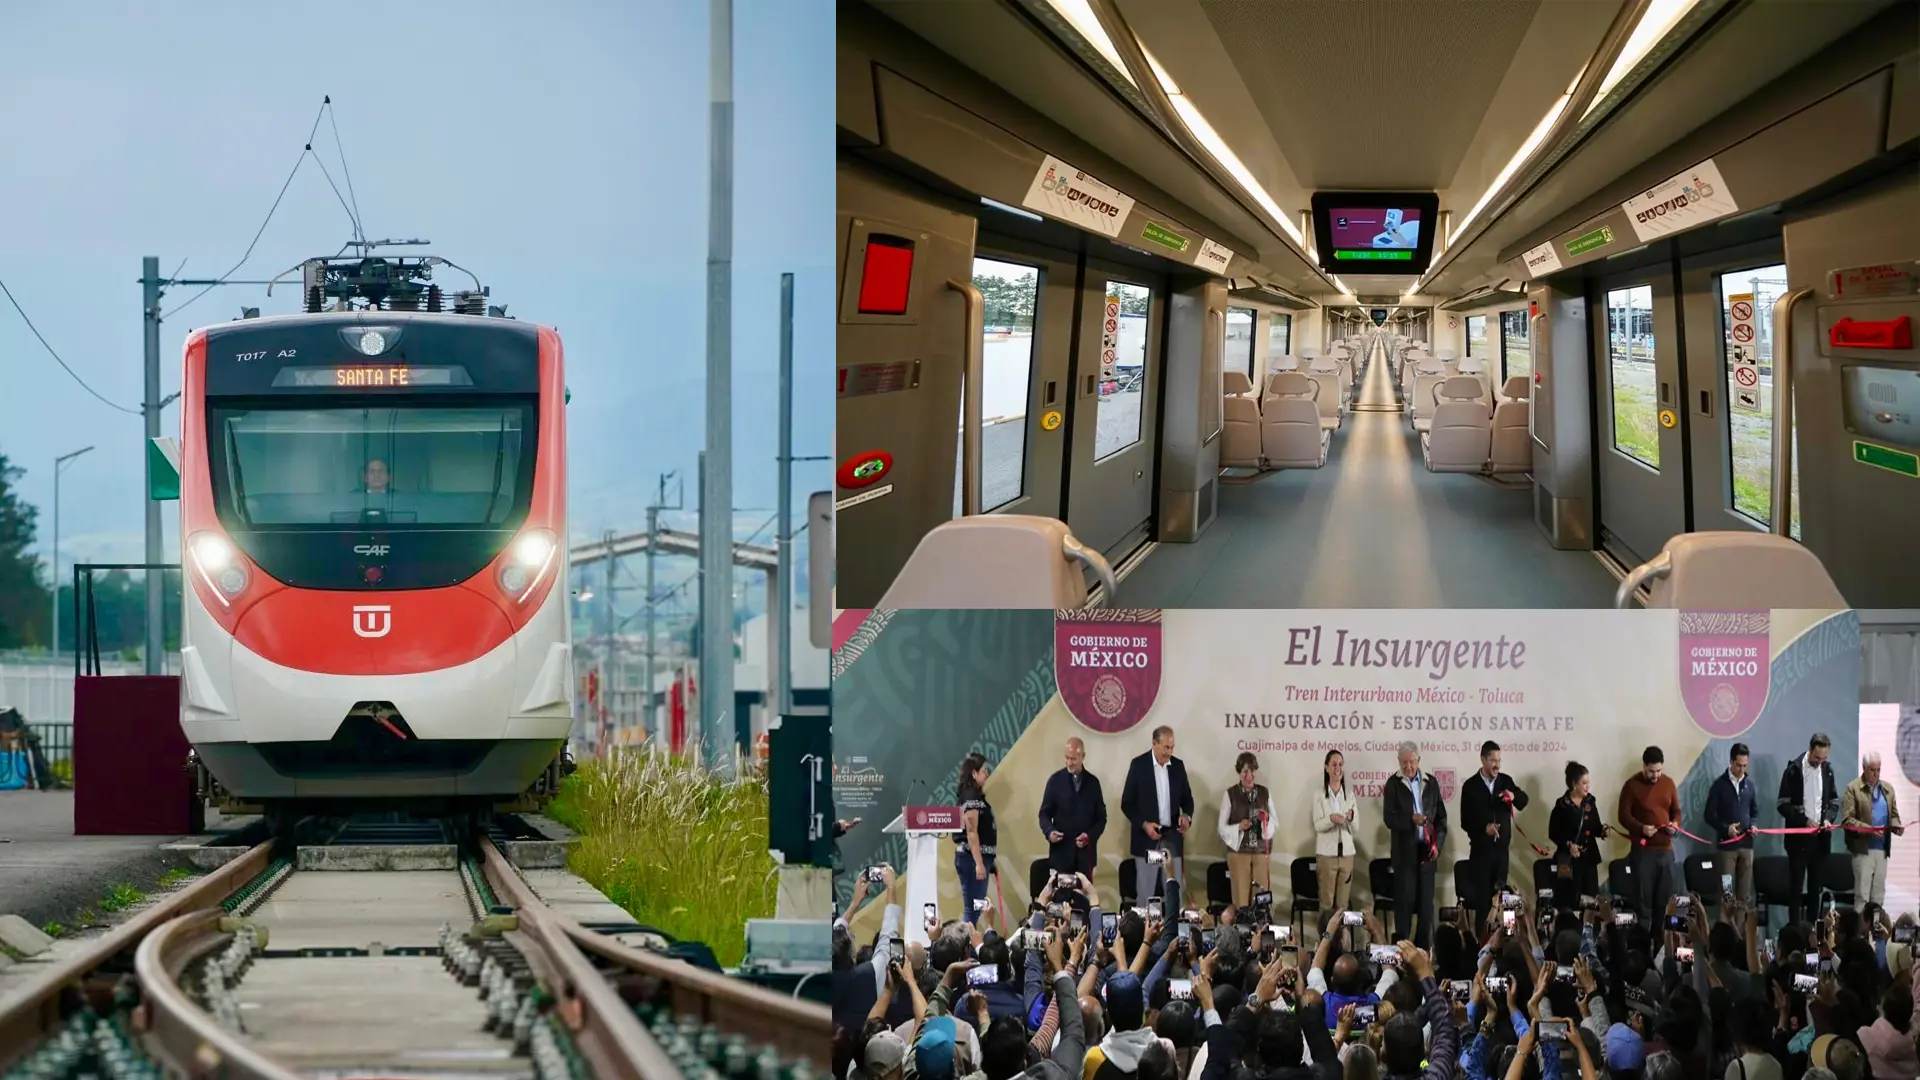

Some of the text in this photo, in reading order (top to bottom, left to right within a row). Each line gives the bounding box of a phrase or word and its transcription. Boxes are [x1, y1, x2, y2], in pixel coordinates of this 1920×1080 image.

[235, 349, 297, 362] T017 A2
[337, 368, 409, 386] SANTA FE
[354, 545, 391, 556] CAF
[1070, 635, 1148, 648] GOBIERNO DE
[1070, 647, 1148, 668] MÉXICO
[1285, 626, 1526, 681] El Insurgente
[1691, 647, 1758, 658] GOBIERNO DE
[1692, 658, 1758, 676] MÉXICO
[1285, 685, 1319, 701] Tren
[1324, 686, 1412, 703] Interurbano
[1416, 686, 1465, 704] México
[1479, 688, 1524, 704] Toluca
[1225, 711, 1374, 730] INAUGURACIÓN
[1393, 712, 1483, 731] ESTACIÓN
[1489, 716, 1547, 731] SANTA
[1554, 717, 1574, 731] FE
[1237, 740, 1298, 753] Cuajimalpa
[1302, 740, 1315, 751] de
[1318, 741, 1362, 753] Morelos,
[1365, 741, 1401, 752] Ciudad
[1421, 742, 1460, 753] México,
[1463, 742, 1472, 752] 31
[1474, 742, 1482, 752] d
[1527, 742, 1540, 752] de
[1543, 742, 1567, 752] 2024
[836, 774, 884, 786] nsurgente
[928, 816, 952, 824] MÉXICO
